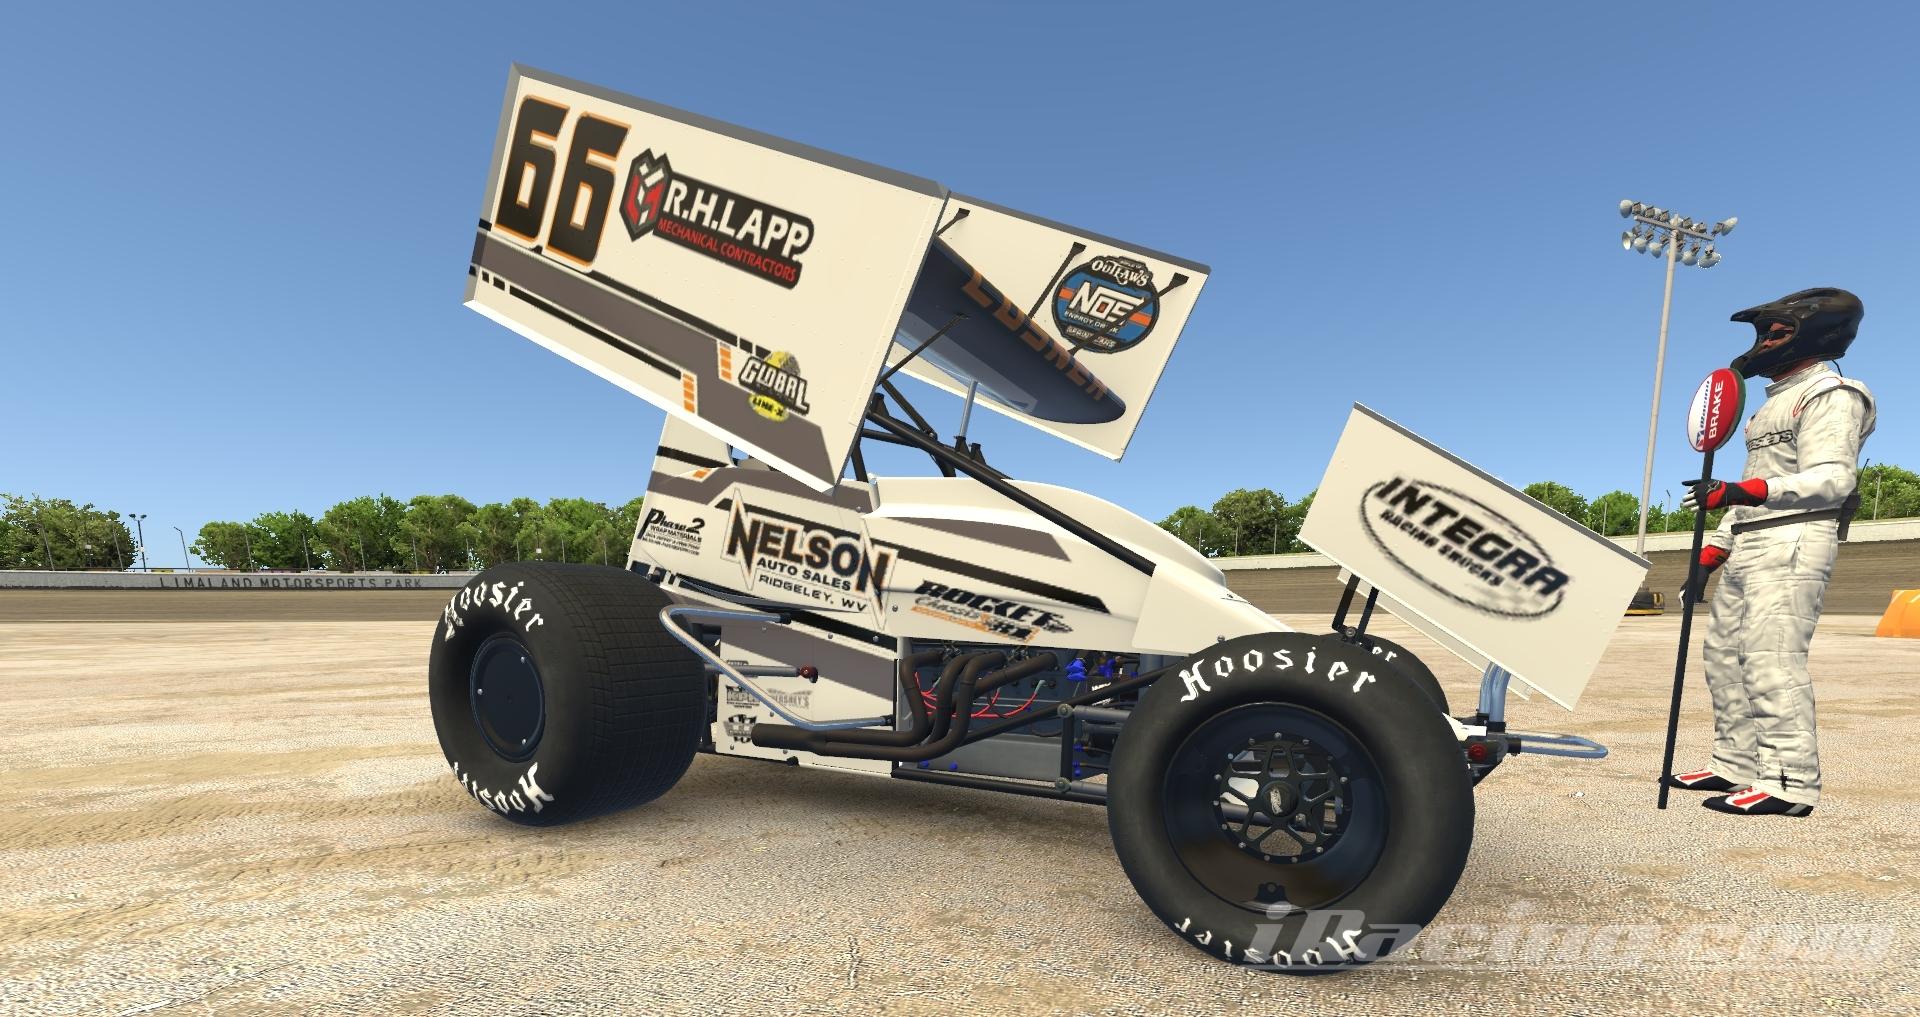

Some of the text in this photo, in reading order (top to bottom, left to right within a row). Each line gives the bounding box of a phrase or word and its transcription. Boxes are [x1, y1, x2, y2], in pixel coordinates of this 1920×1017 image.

[494, 94, 632, 268] 66
[658, 218, 798, 283] MECHANICAL CONTRACTORS
[1069, 281, 1145, 325] NOS
[740, 359, 809, 411] GLOBAL
[1708, 381, 1724, 439] BRAKE
[726, 500, 892, 613] NELSON
[1375, 477, 1570, 596] INTEGRA
[259, 577, 377, 589] MOTORSPORTS
[384, 577, 422, 589] PARK
[757, 556, 852, 592] AUTO SALES
[444, 580, 544, 641] Hoosier
[841, 597, 868, 613] WV
[1178, 646, 1377, 703] Hoosier
[1174, 917, 1368, 968] Hoosier
